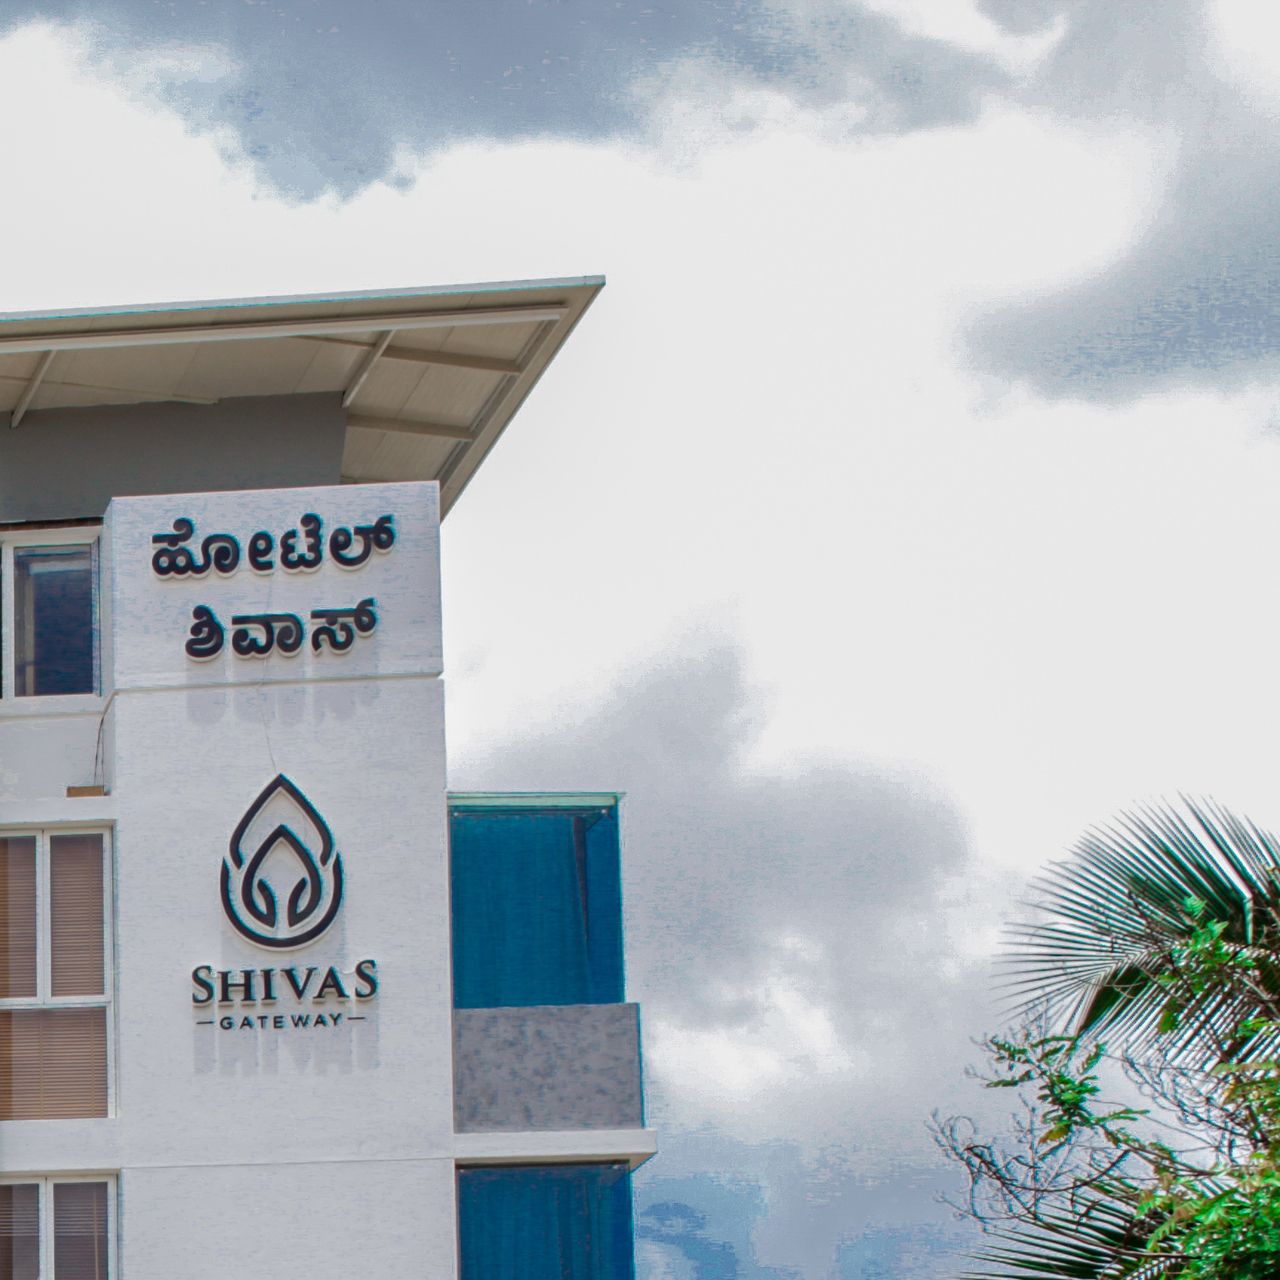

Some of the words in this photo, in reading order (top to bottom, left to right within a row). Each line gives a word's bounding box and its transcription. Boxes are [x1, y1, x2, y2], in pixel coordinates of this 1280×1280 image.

[151, 512, 396, 577] ಹೋಟೆಲ್
[185, 597, 377, 661] ಶಿವಾಸ್
[191, 959, 378, 1005] SHIVAS
[219, 1013, 342, 1030] GATEWAY
